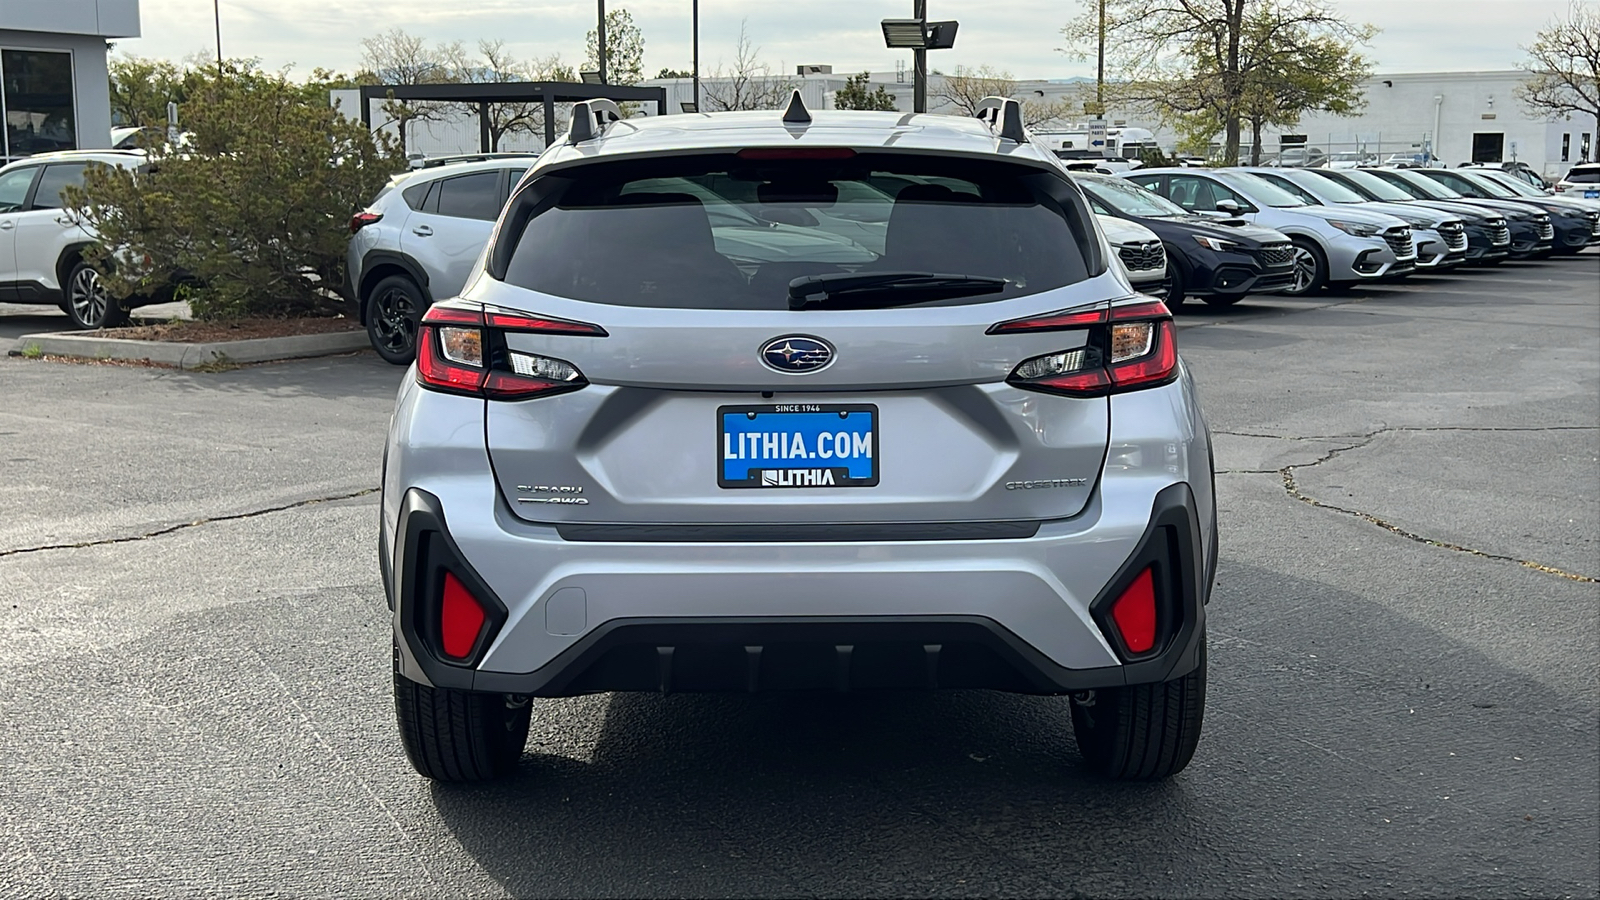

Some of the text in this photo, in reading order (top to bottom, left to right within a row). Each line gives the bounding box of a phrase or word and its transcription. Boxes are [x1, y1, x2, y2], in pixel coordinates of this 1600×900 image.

[724, 432, 873, 459] LITHIA.COM
[778, 469, 835, 486] LITHIA
[517, 485, 584, 494] SUBARU
[1005, 478, 1087, 490] CROSSTREK
[546, 497, 590, 505] AWD
